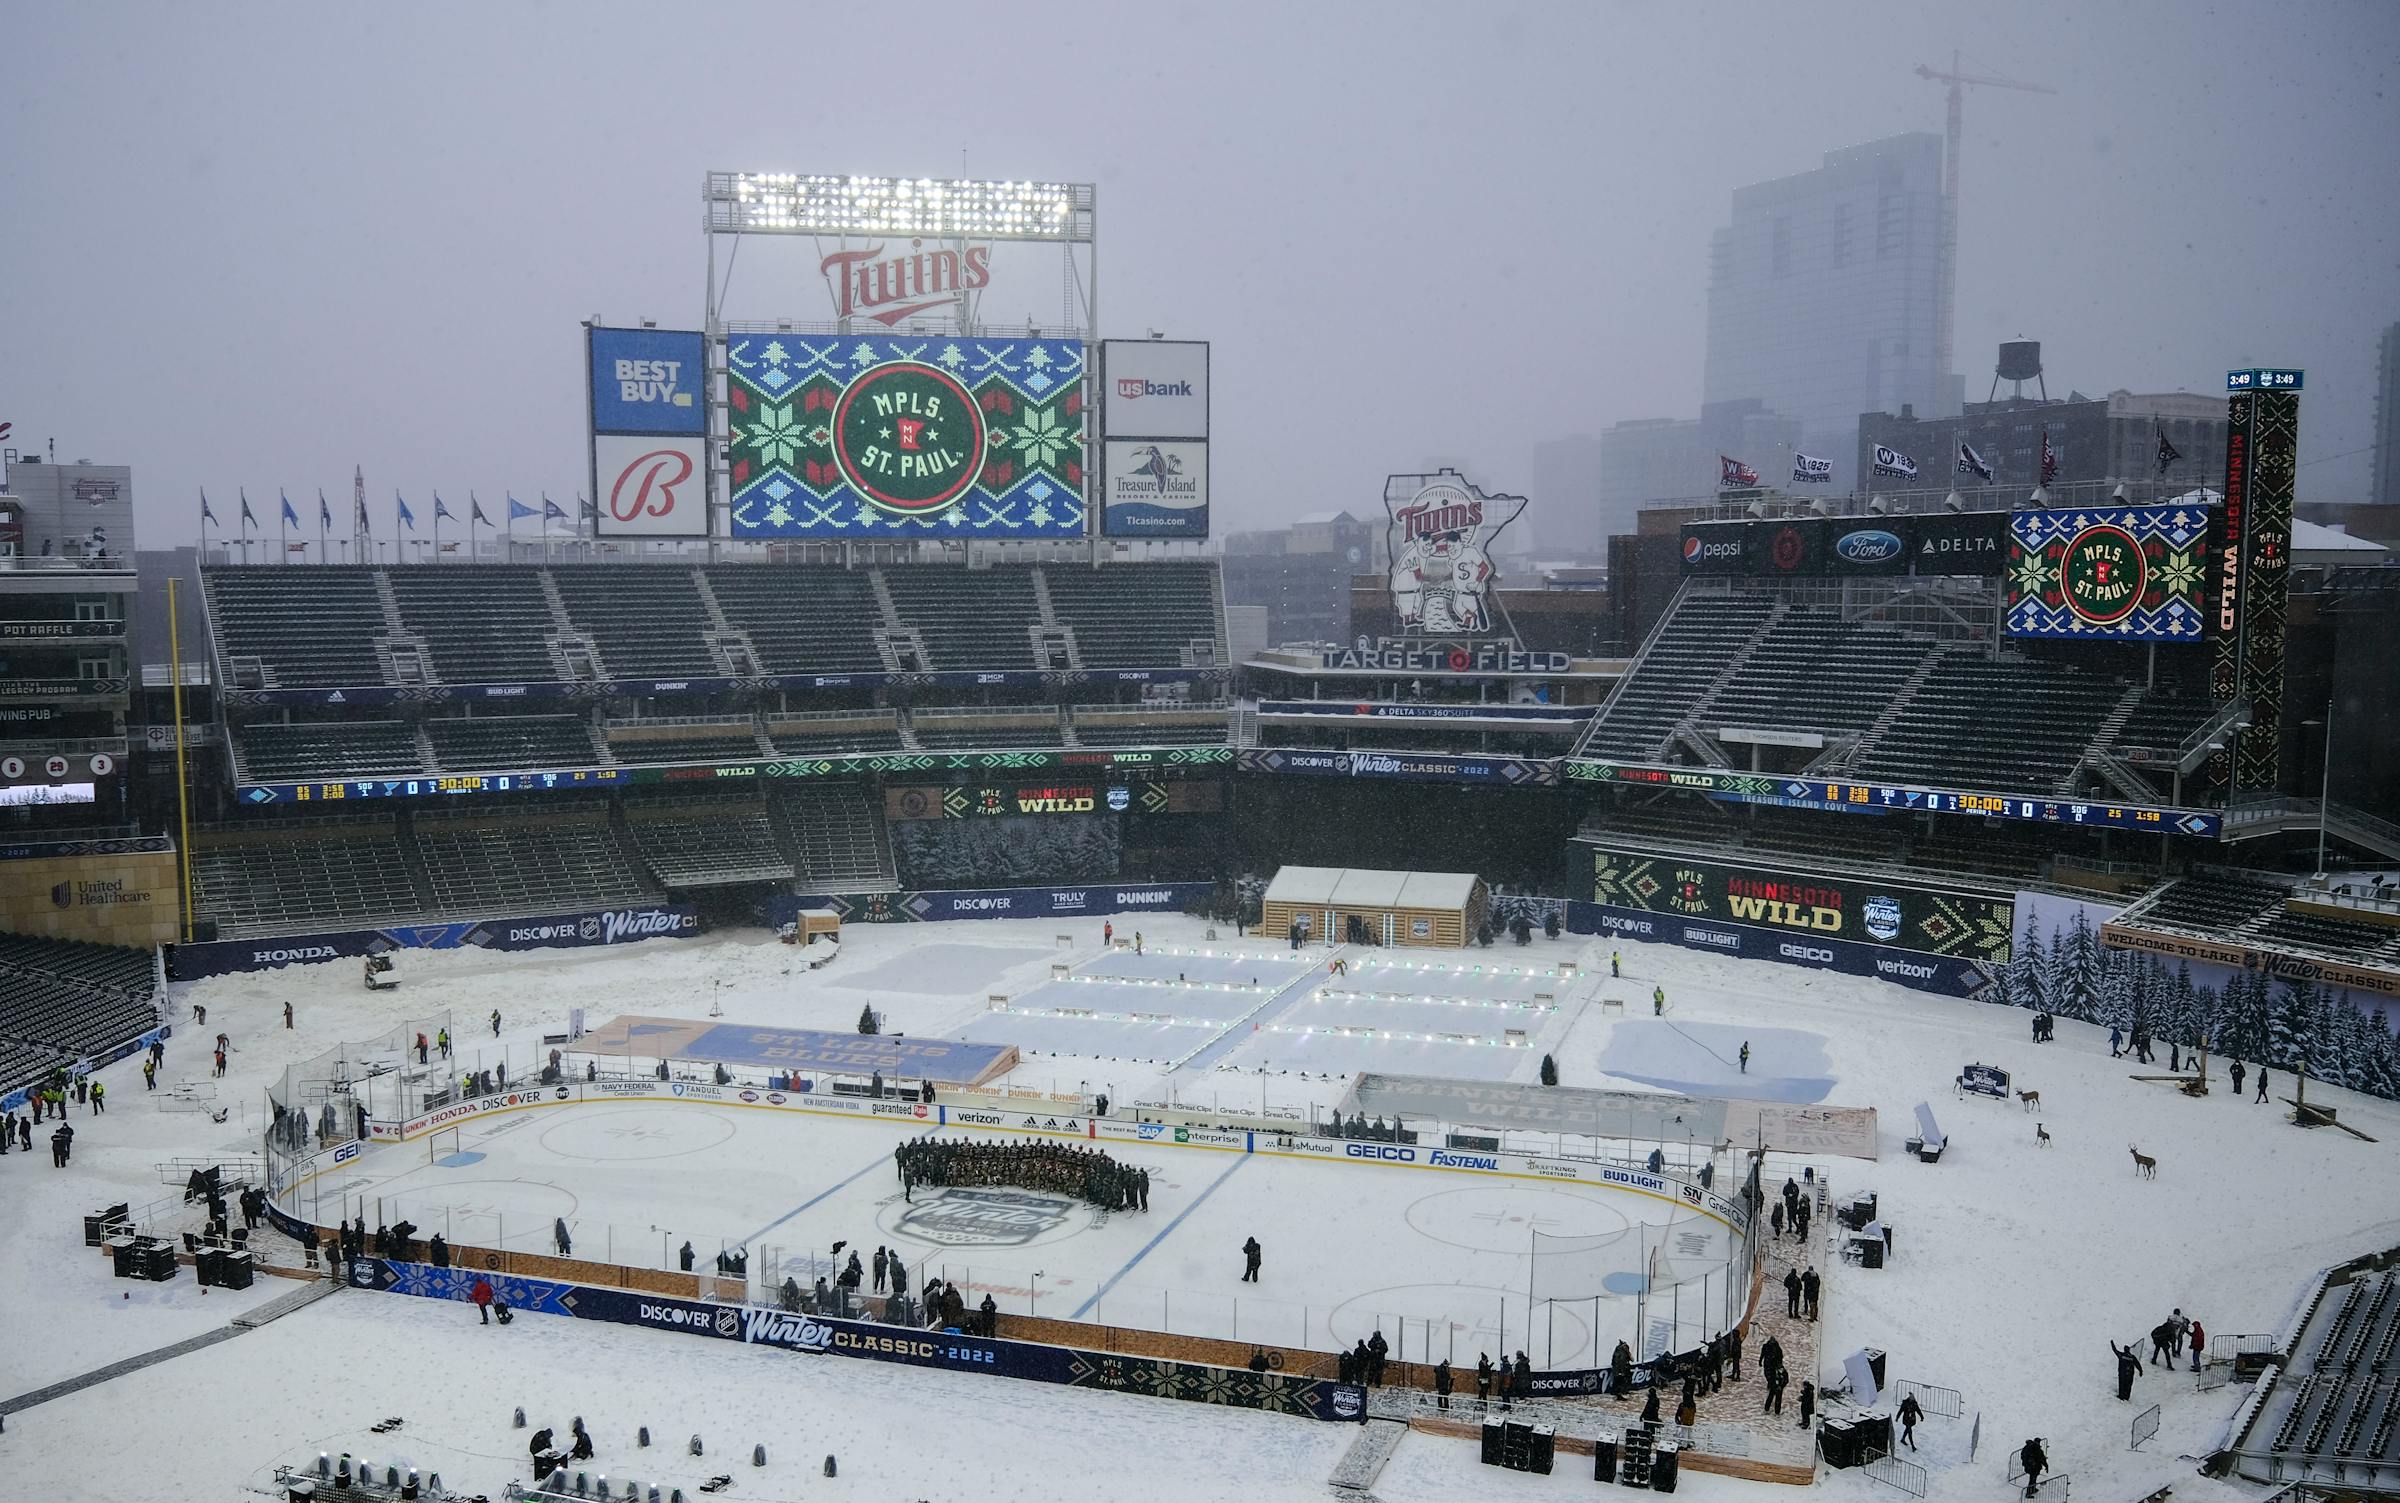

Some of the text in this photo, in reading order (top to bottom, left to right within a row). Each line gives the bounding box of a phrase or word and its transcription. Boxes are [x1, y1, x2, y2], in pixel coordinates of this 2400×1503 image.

[821, 239, 990, 320] Twins
[615, 359, 681, 382] BEST
[2230, 374, 2250, 385] 3:49
[2275, 374, 2294, 384] 3:49
[621, 381, 676, 403] BUY
[872, 391, 945, 423] MPLS.
[861, 445, 894, 476] ST.
[1880, 449, 1892, 460] W
[610, 449, 693, 522] B
[1115, 476, 1196, 492] Treasure Island
[1396, 500, 1483, 543] Twins
[2221, 434, 2243, 631] MINNESOTA WILD
[1703, 540, 1741, 560] pepsi
[1848, 536, 1889, 558] Ford
[1940, 537, 1996, 553] DELTA
[2083, 544, 2124, 564] MPLS.
[2075, 579, 2092, 599] ST.
[4, 624, 73, 635] POT RAFFLE
[1323, 650, 1571, 672] TARGET FIELD
[1119, 672, 1150, 680] DISCOVER
[28, 709, 51, 720] PUB
[1389, 708, 1415, 716] DELTA
[1113, 753, 1152, 762] WILD
[1291, 753, 1489, 777] DISCOVER Winter CLASSIC 2022
[9, 760, 106, 772] 6 29 3
[716, 767, 756, 777] WILD
[358, 782, 373, 790] SOG
[438, 776, 481, 790] 30:00
[1669, 773, 1714, 787] WILD
[1880, 789, 1895, 798] SOG
[1018, 797, 1095, 813] WILD
[1742, 793, 1847, 812] TREASURE ISLAND COVE
[1959, 796, 2003, 811] 30:00
[2071, 805, 2087, 815] SOG
[2108, 808, 2160, 821] 25 1:58
[78, 879, 122, 894] United
[1675, 870, 1704, 887] MPLS.
[79, 892, 151, 905] Healthcare
[1052, 892, 1086, 902] TRULY
[1117, 891, 1172, 904] DUNKIN'
[1728, 877, 1842, 909] MINNESOTA
[954, 897, 1011, 910] DISCOVER
[1669, 896, 1710, 913] ST. PAUL
[874, 910, 894, 921] PAUL
[1727, 894, 1842, 932] WILD
[1863, 906, 1902, 923] Winter
[510, 924, 576, 941] DISCOVER
[602, 909, 682, 944] Winter
[1602, 915, 1652, 934] DISCOVER
[1685, 929, 1738, 947] BUD LIGHT
[253, 946, 339, 962] HONDA
[1779, 943, 1833, 963] GEICO
[1876, 958, 1932, 979] verizon
[2107, 932, 2395, 991] WELCOME TO LAKE Winter CLASSIC
[821, 1037, 950, 1058] LOUIS
[759, 1047, 904, 1066] BLUES
[602, 1083, 623, 1091] NAVY
[686, 1085, 721, 1095] FANDUEL
[482, 1091, 541, 1110] DISCOVER
[803, 1098, 815, 1106] NEW
[815, 1099, 844, 1109] AMSTERDAM
[1134, 1099, 1168, 1110] Great Clips
[1177, 1103, 1212, 1114] Great Clips
[431, 1103, 477, 1124] HONDA
[872, 1102, 911, 1116] guaranteed
[1219, 1106, 1255, 1117] Great Clips
[1263, 1110, 1300, 1121] Great Clips
[1465, 1101, 1601, 1123] WILD
[958, 1111, 1000, 1125] verizon
[1138, 1125, 1159, 1138] SAP
[1178, 1129, 1239, 1144] enterprise
[1346, 1143, 1415, 1162] GEICO
[1429, 1150, 1499, 1170] FASTENAL
[1603, 1170, 1664, 1191] BUD LIGHT
[1683, 1186, 1703, 1201] SN
[905, 1198, 1068, 1225] Winter
[1708, 1196, 1732, 1219] Great
[938, 1222, 1001, 1234] DISCOVER
[640, 1303, 994, 1364] DISCOVER Winter CLASSIC 2022
[1102, 1358, 1123, 1370] MPLS.
[1098, 1373, 1127, 1386] ST. PAUL
[1531, 1379, 1580, 1390] DISCOVER
[1332, 1392, 1360, 1405] Winter
